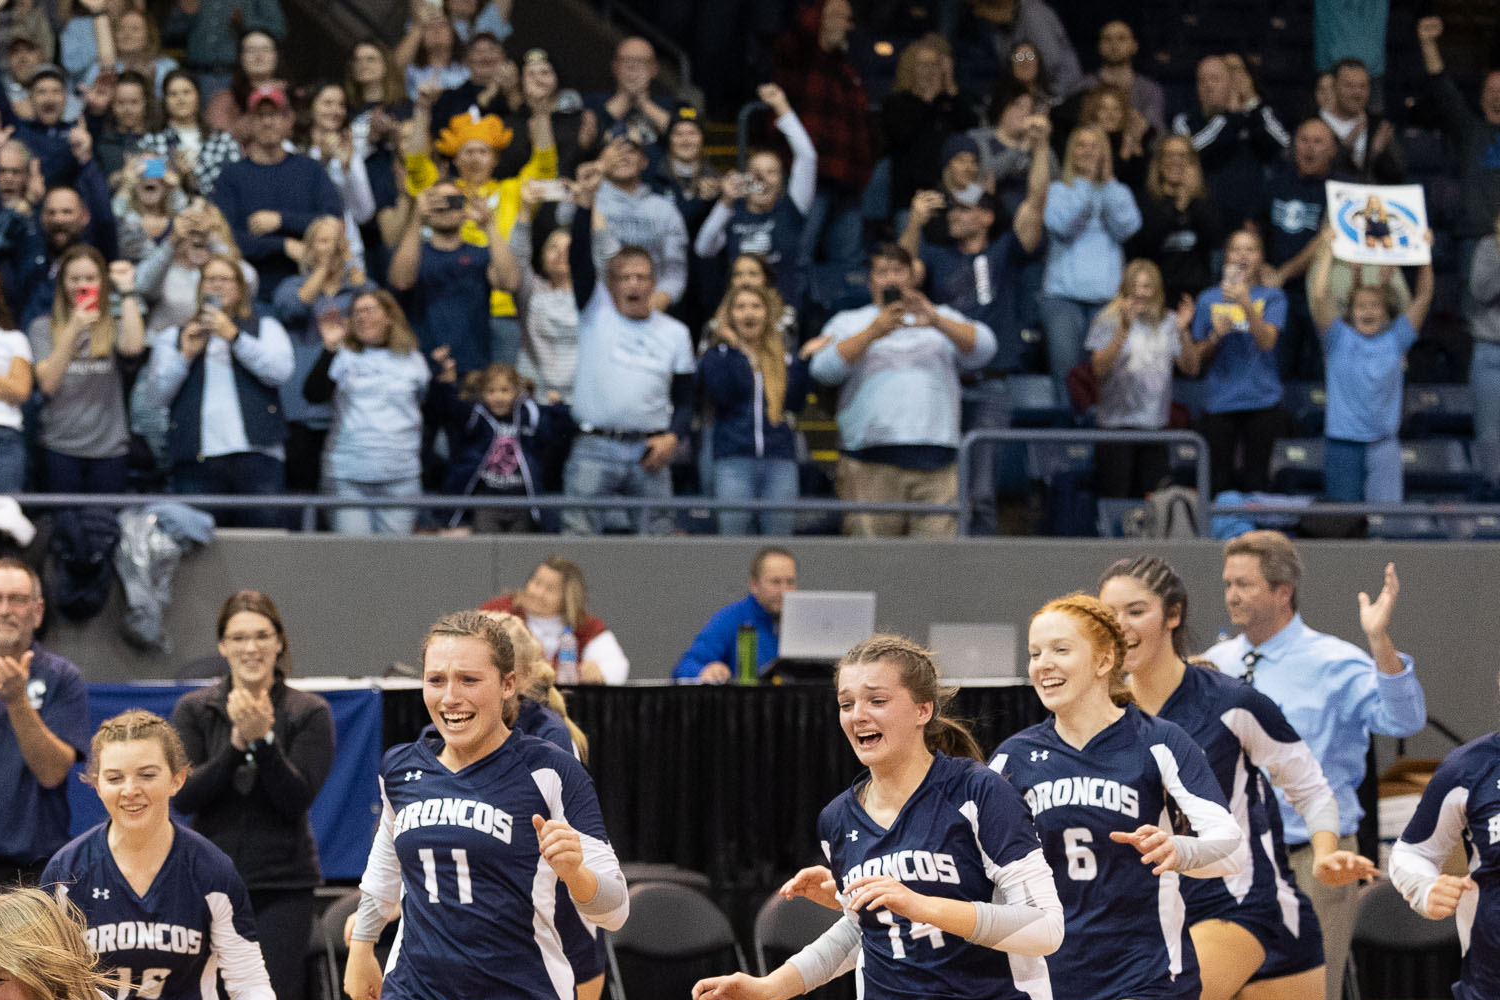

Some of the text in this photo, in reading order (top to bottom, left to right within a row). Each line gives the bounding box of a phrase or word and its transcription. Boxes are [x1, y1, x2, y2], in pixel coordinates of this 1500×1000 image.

[418, 848, 474, 905] 11
[842, 849, 961, 898] RONCOS
[1062, 827, 1098, 881] 6
[82, 920, 203, 955] BRONCOS
[876, 909, 946, 959] 14
